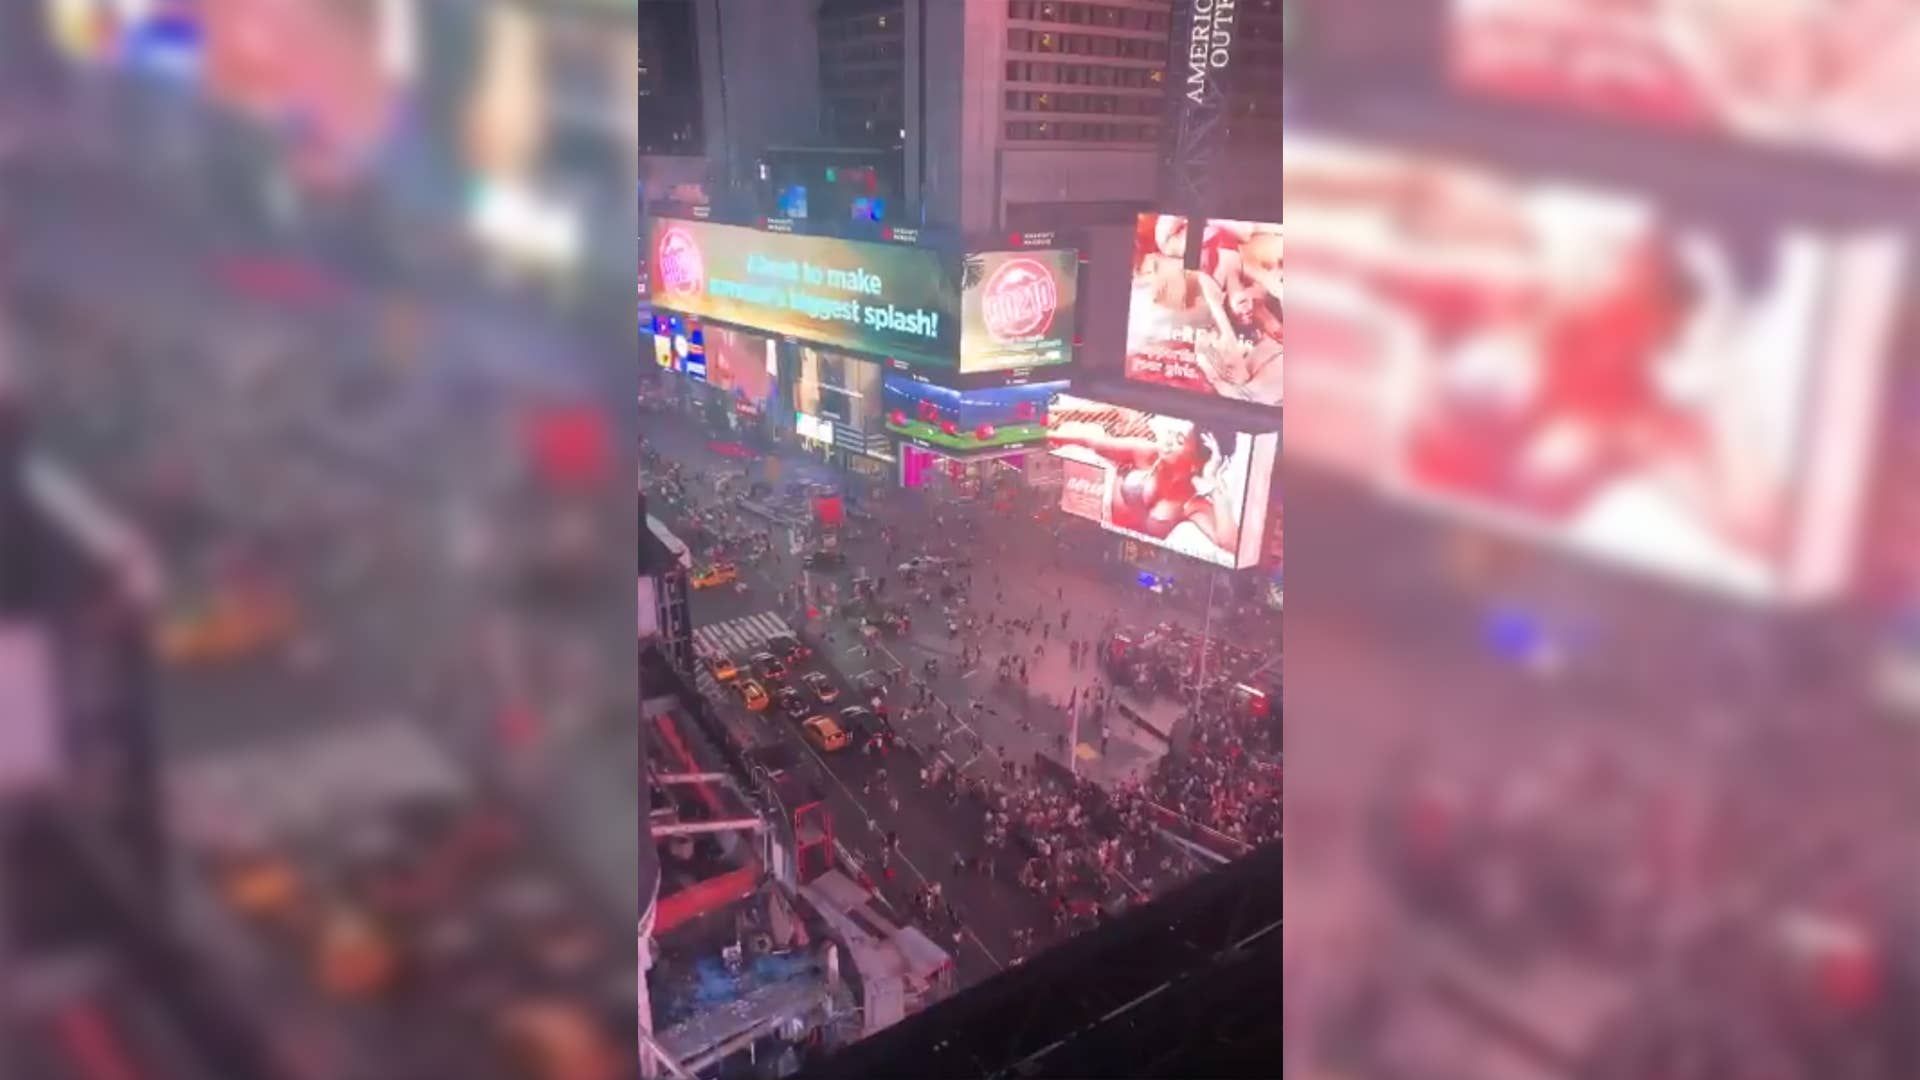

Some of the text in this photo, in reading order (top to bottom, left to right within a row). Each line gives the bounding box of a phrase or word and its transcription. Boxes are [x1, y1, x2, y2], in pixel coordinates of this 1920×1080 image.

[1186, 0, 1214, 104] AMERIC
[827, 267, 881, 295] make
[790, 288, 860, 322] ggest
[864, 304, 938, 337] splash!
